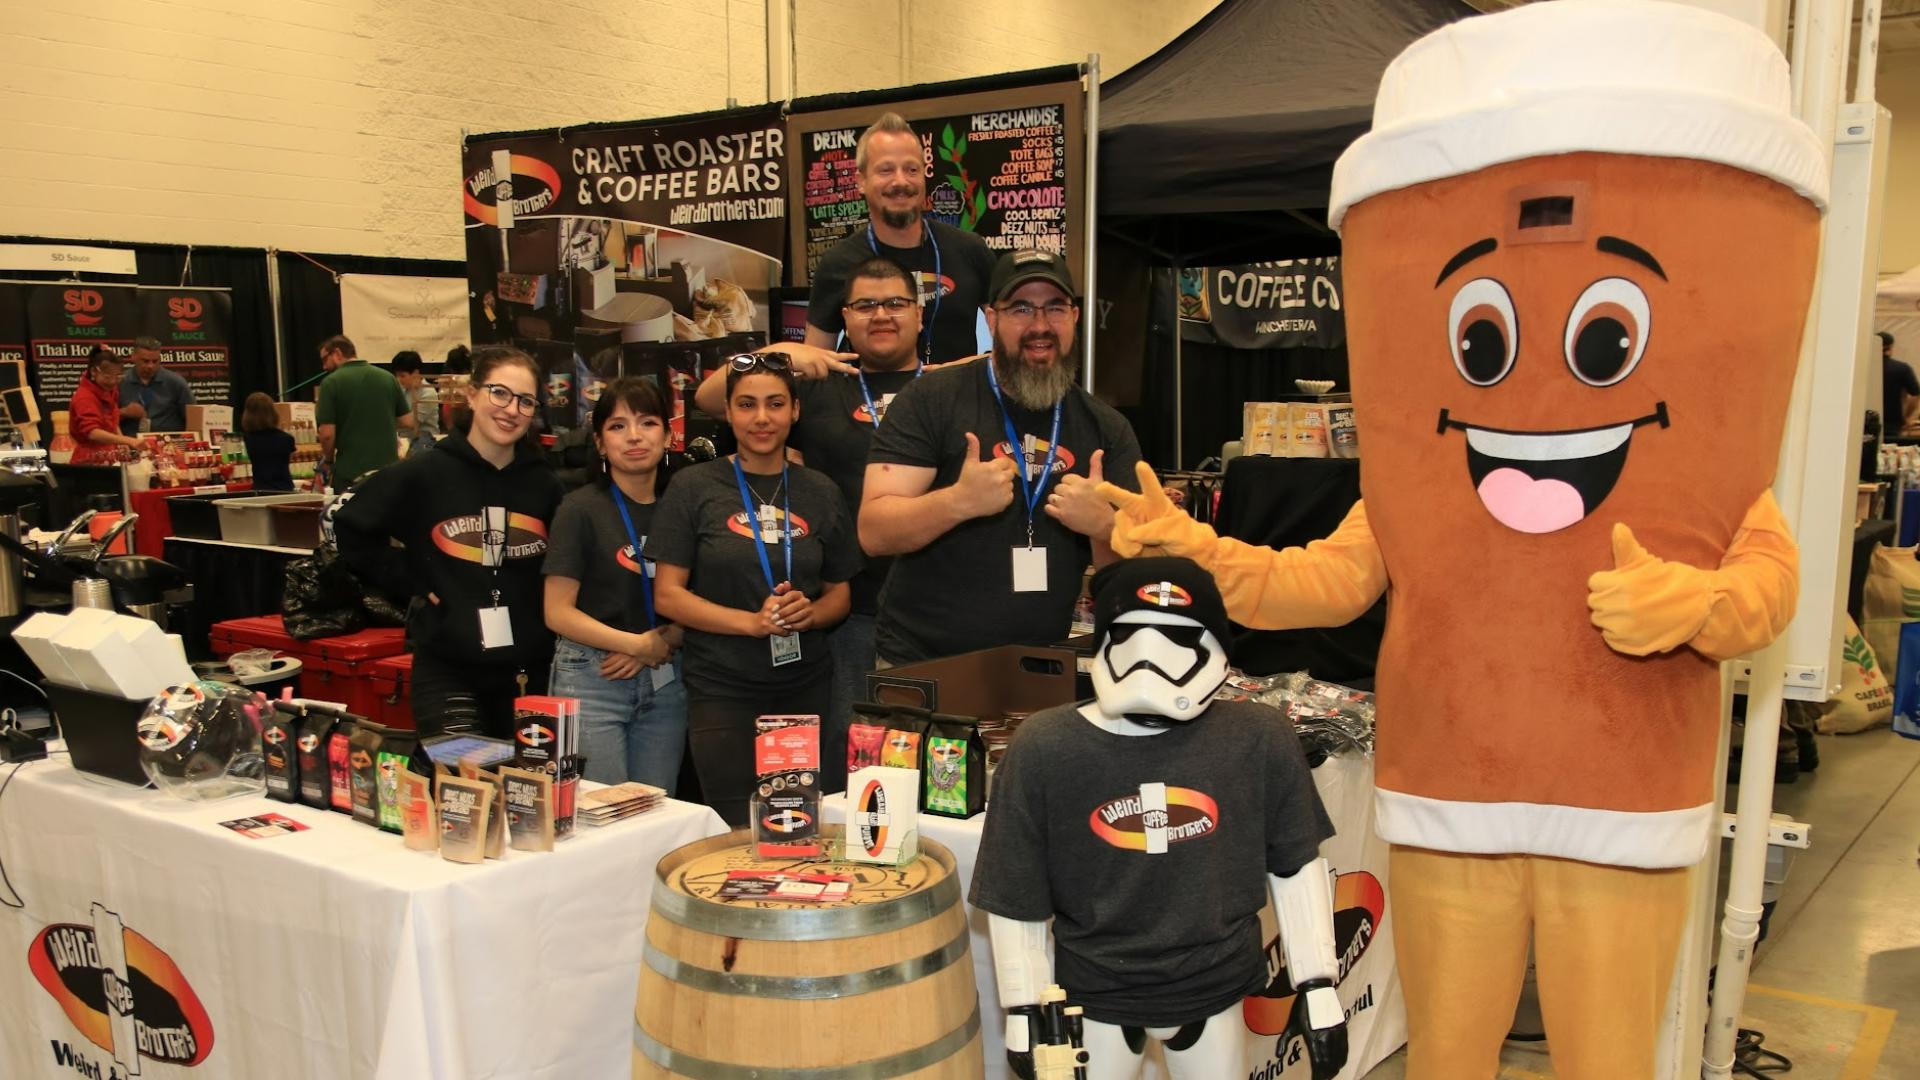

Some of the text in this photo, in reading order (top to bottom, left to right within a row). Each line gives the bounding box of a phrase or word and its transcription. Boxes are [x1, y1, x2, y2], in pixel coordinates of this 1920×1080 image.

[971, 106, 1059, 131] MERCHANDISE
[1025, 125, 1056, 137] COFFEE
[572, 128, 784, 175] CRAFT ROASTER
[1022, 137, 1054, 149] SOCKS
[1010, 149, 1034, 161] TOTE
[1035, 147, 1054, 159] BAGS
[1001, 161, 1035, 175] COFFEE
[577, 161, 781, 205] & COFFEE BARS
[990, 174, 1019, 187] COFFEE
[987, 186, 1066, 210] CHOCOLATE
[670, 197, 784, 225] weirdbrothers.com
[1005, 209, 1031, 221] COOL
[1001, 221, 1024, 235] DEEZ
[1024, 221, 1048, 234] NUTS
[1218, 269, 1306, 309] COFFEE
[64, 289, 103, 312] SD
[168, 298, 202, 318] SD
[67, 327, 106, 336] SAUCE
[172, 332, 204, 340] SAUCE
[36, 344, 67, 357] Thai
[176, 351, 197, 362] Hot
[444, 517, 482, 538] Weird
[1101, 797, 1143, 824] Weird
[47, 928, 101, 971] Weird
